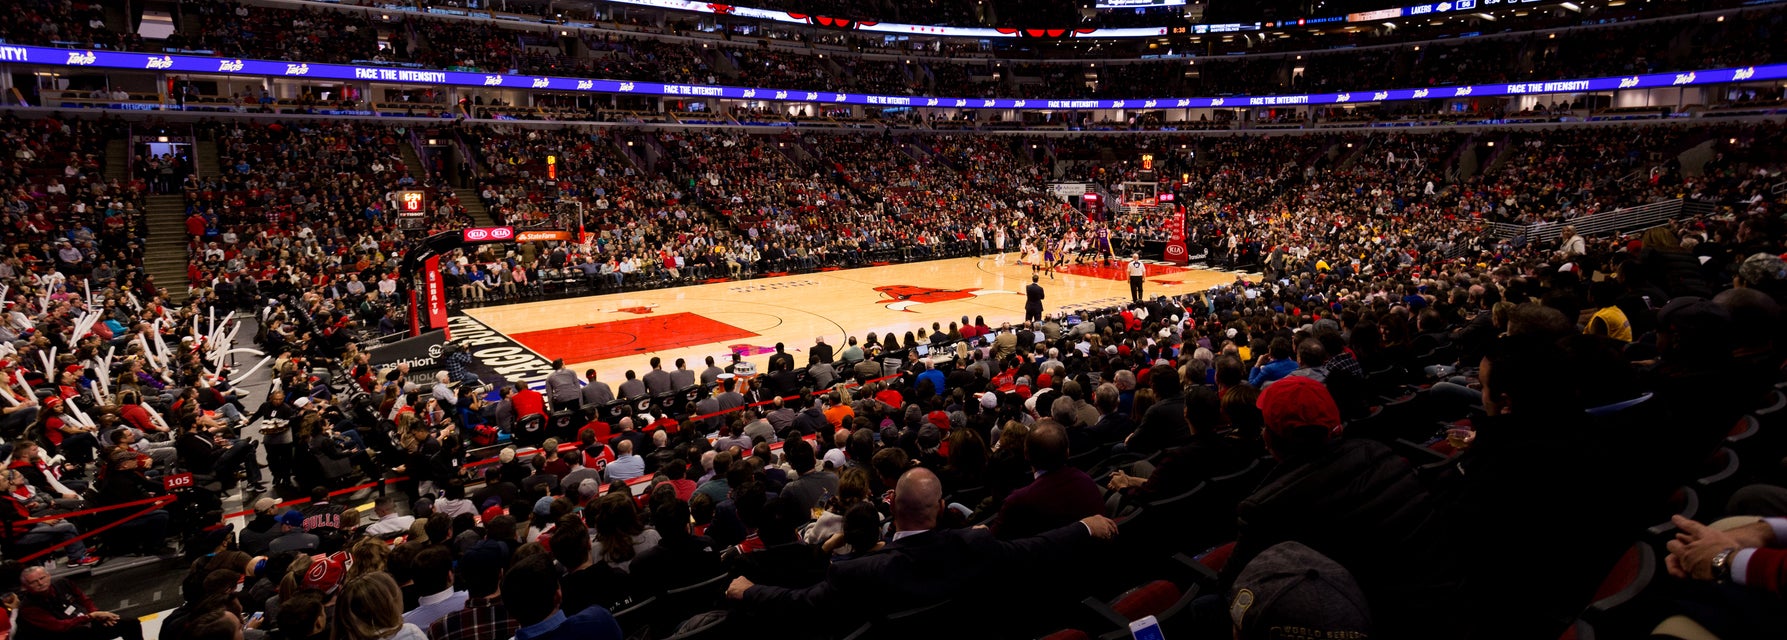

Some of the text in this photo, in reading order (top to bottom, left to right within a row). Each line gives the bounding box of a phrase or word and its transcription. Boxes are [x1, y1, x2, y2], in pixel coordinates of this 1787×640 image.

[1411, 5, 1432, 15] LAKERS
[67, 51, 96, 65] Takis
[146, 56, 173, 69] Takis
[219, 60, 244, 71] Takis
[285, 64, 309, 75] Takis
[356, 68, 445, 82] FACE THE INTENSITY!
[664, 85, 679, 93] FACE
[680, 86, 691, 94] THE
[1508, 81, 1589, 93] FACE THE INTENSITY!
[407, 201, 418, 210] 10
[431, 302, 439, 315] TV
[167, 476, 190, 487] 105
[303, 513, 341, 532] BULLS
